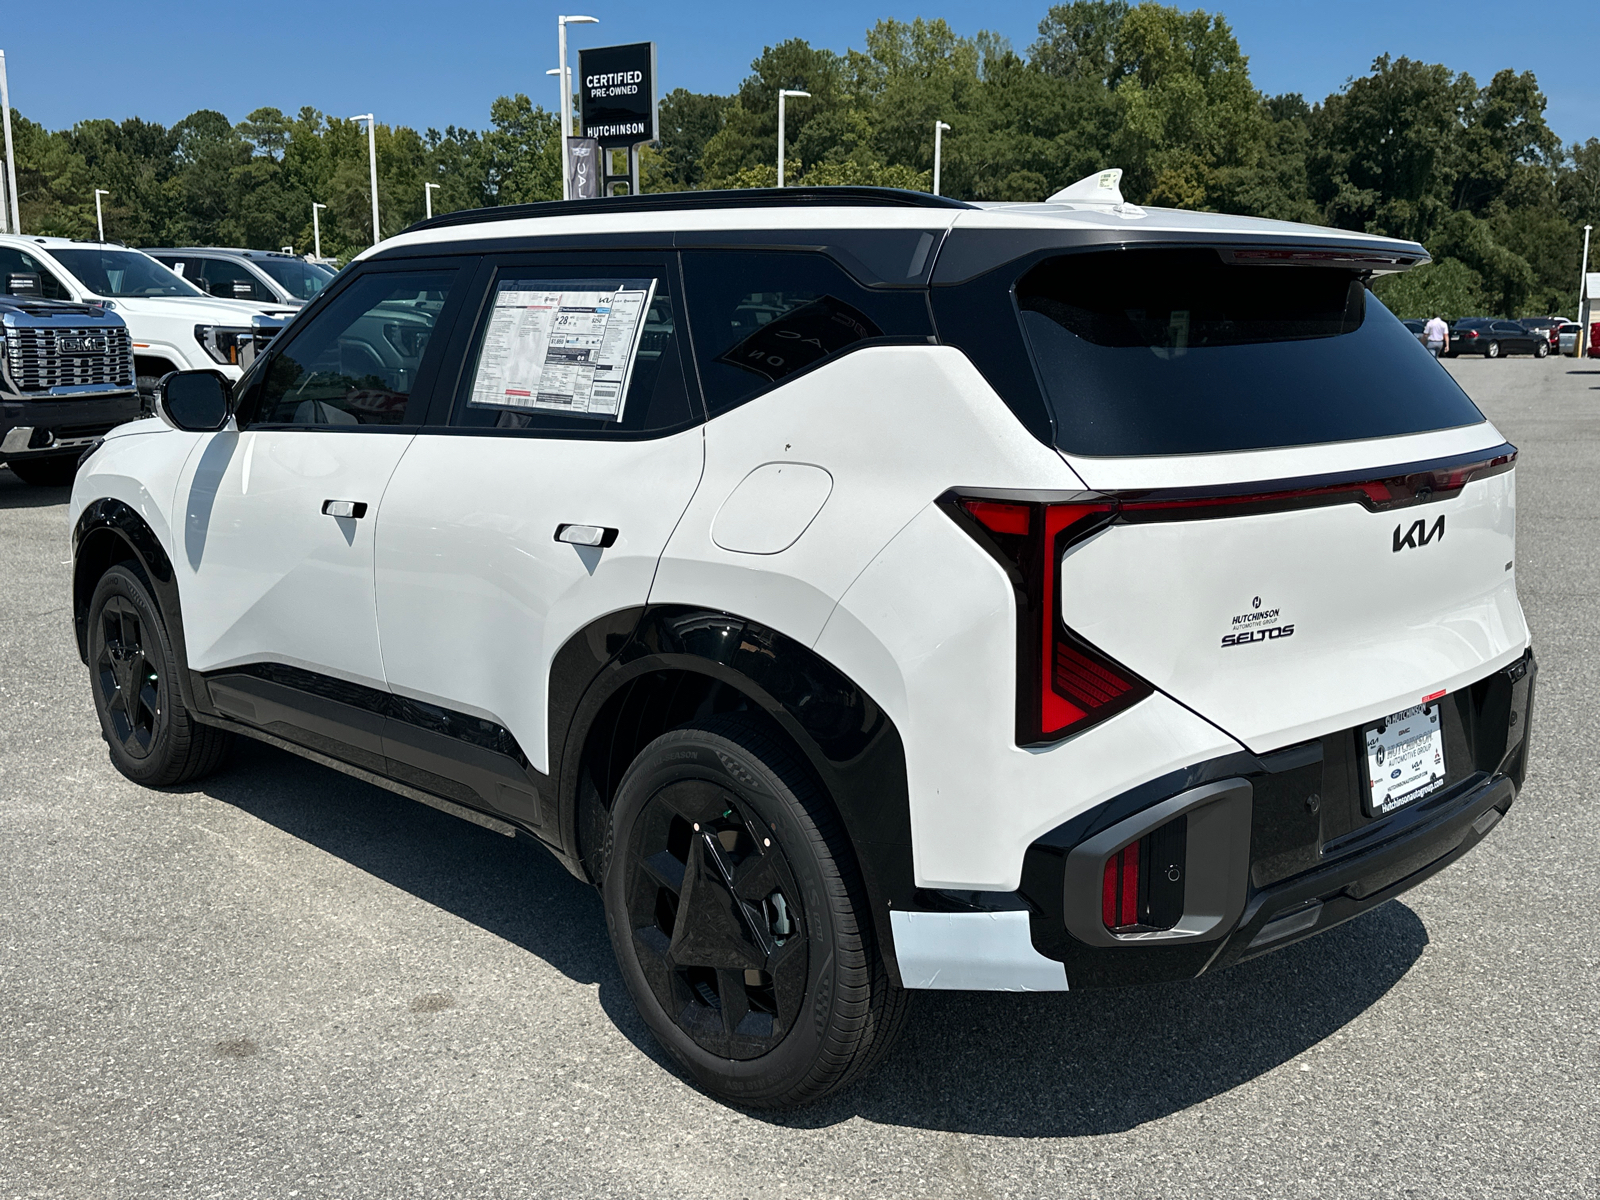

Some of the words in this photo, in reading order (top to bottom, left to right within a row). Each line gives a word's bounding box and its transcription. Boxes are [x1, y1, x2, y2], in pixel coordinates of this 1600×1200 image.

[586, 70, 642, 88] CERTIFIED
[591, 84, 638, 98] PRE-OWNED
[587, 122, 645, 138] HUTCHINSON
[558, 316, 569, 324] 28
[63, 337, 107, 352] GMC
[1392, 514, 1446, 553] KIA
[1232, 608, 1280, 625] HUTCHINSON
[1232, 621, 1262, 631] AUTOMOTIVE
[1262, 618, 1278, 626] GROUP
[1221, 624, 1295, 648] SELTOS
[1392, 703, 1427, 724] HUTCHINSON
[1388, 752, 1417, 767] AUTOMOTIVE
[1417, 744, 1432, 756] GROUP
[1382, 778, 1444, 814] Hutchinsonautogroup.com
